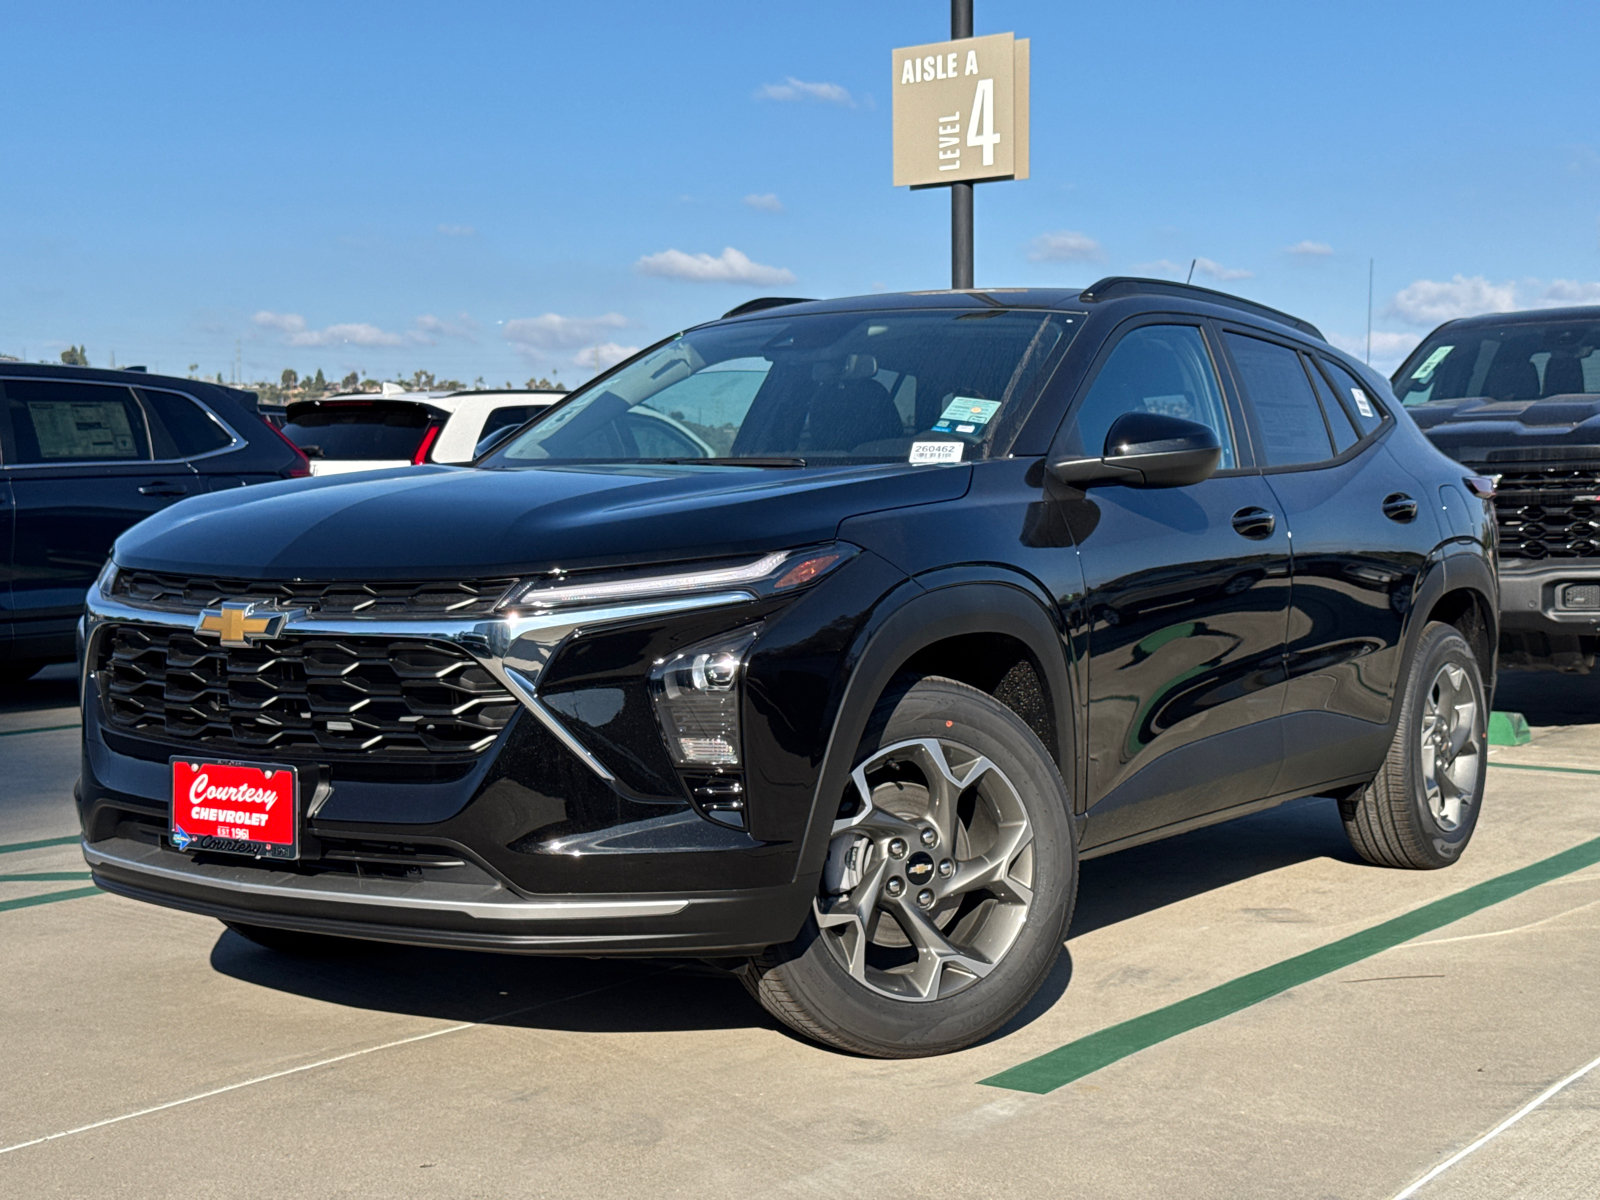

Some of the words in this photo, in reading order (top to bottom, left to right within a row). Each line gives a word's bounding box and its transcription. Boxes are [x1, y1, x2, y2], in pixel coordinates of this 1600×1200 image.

[901, 52, 958, 85] AISLE
[964, 49, 979, 76] A
[938, 111, 960, 171] LEVEL
[966, 78, 1001, 166] 4
[914, 445, 956, 453] 260462
[189, 774, 278, 811] Courtesy
[191, 806, 269, 827] CHEVROLET
[230, 827, 250, 840] 1961
